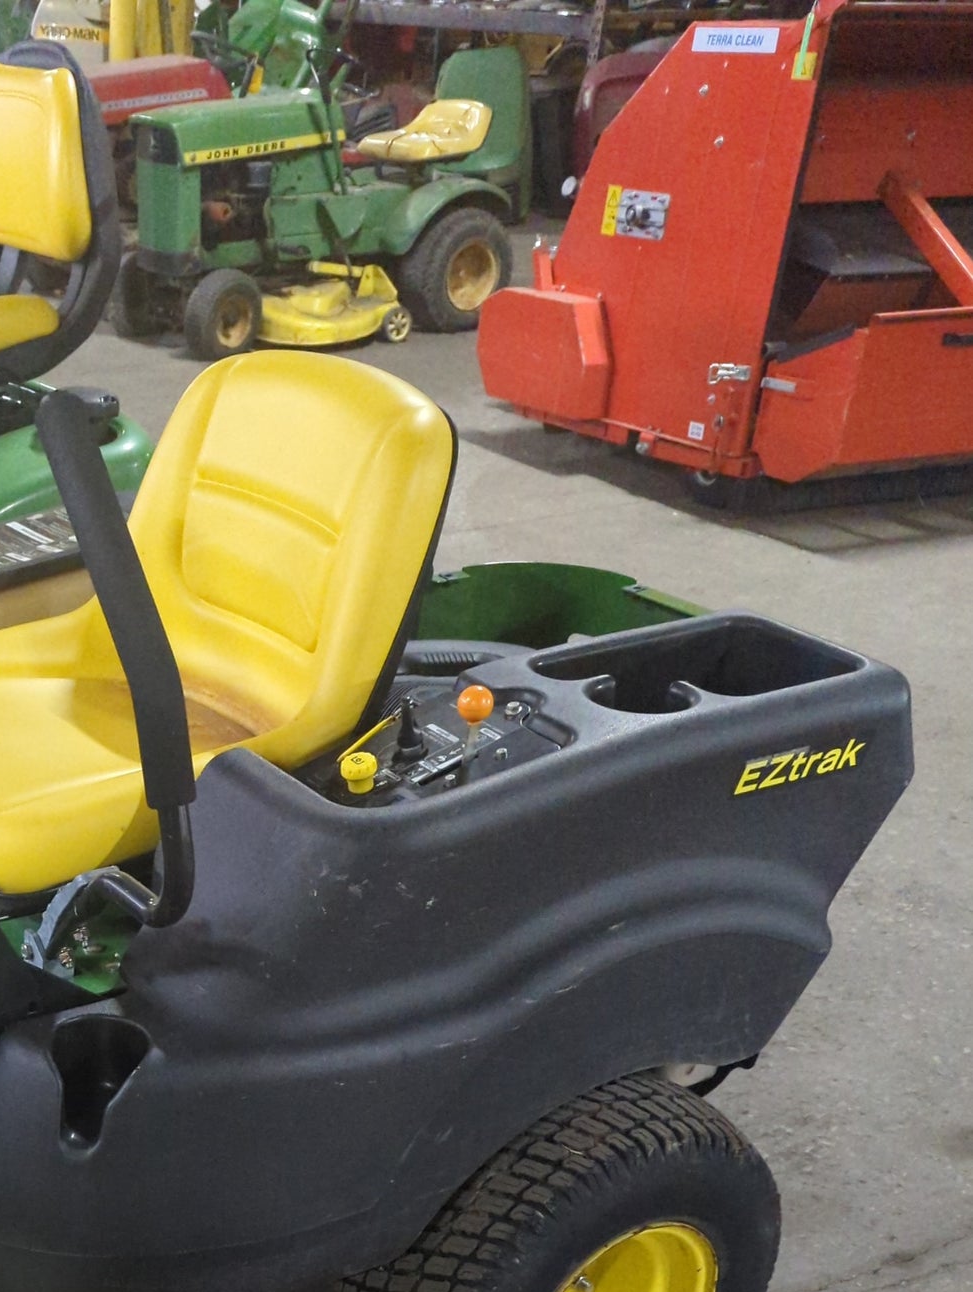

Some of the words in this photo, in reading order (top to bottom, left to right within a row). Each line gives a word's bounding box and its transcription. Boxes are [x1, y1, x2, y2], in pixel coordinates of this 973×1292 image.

[707, 34, 733, 46] TERRA
[735, 34, 765, 47] CLEAN
[206, 148, 240, 160] JOHN
[247, 140, 287, 155] DEERE
[733, 738, 867, 796] EZtrak
